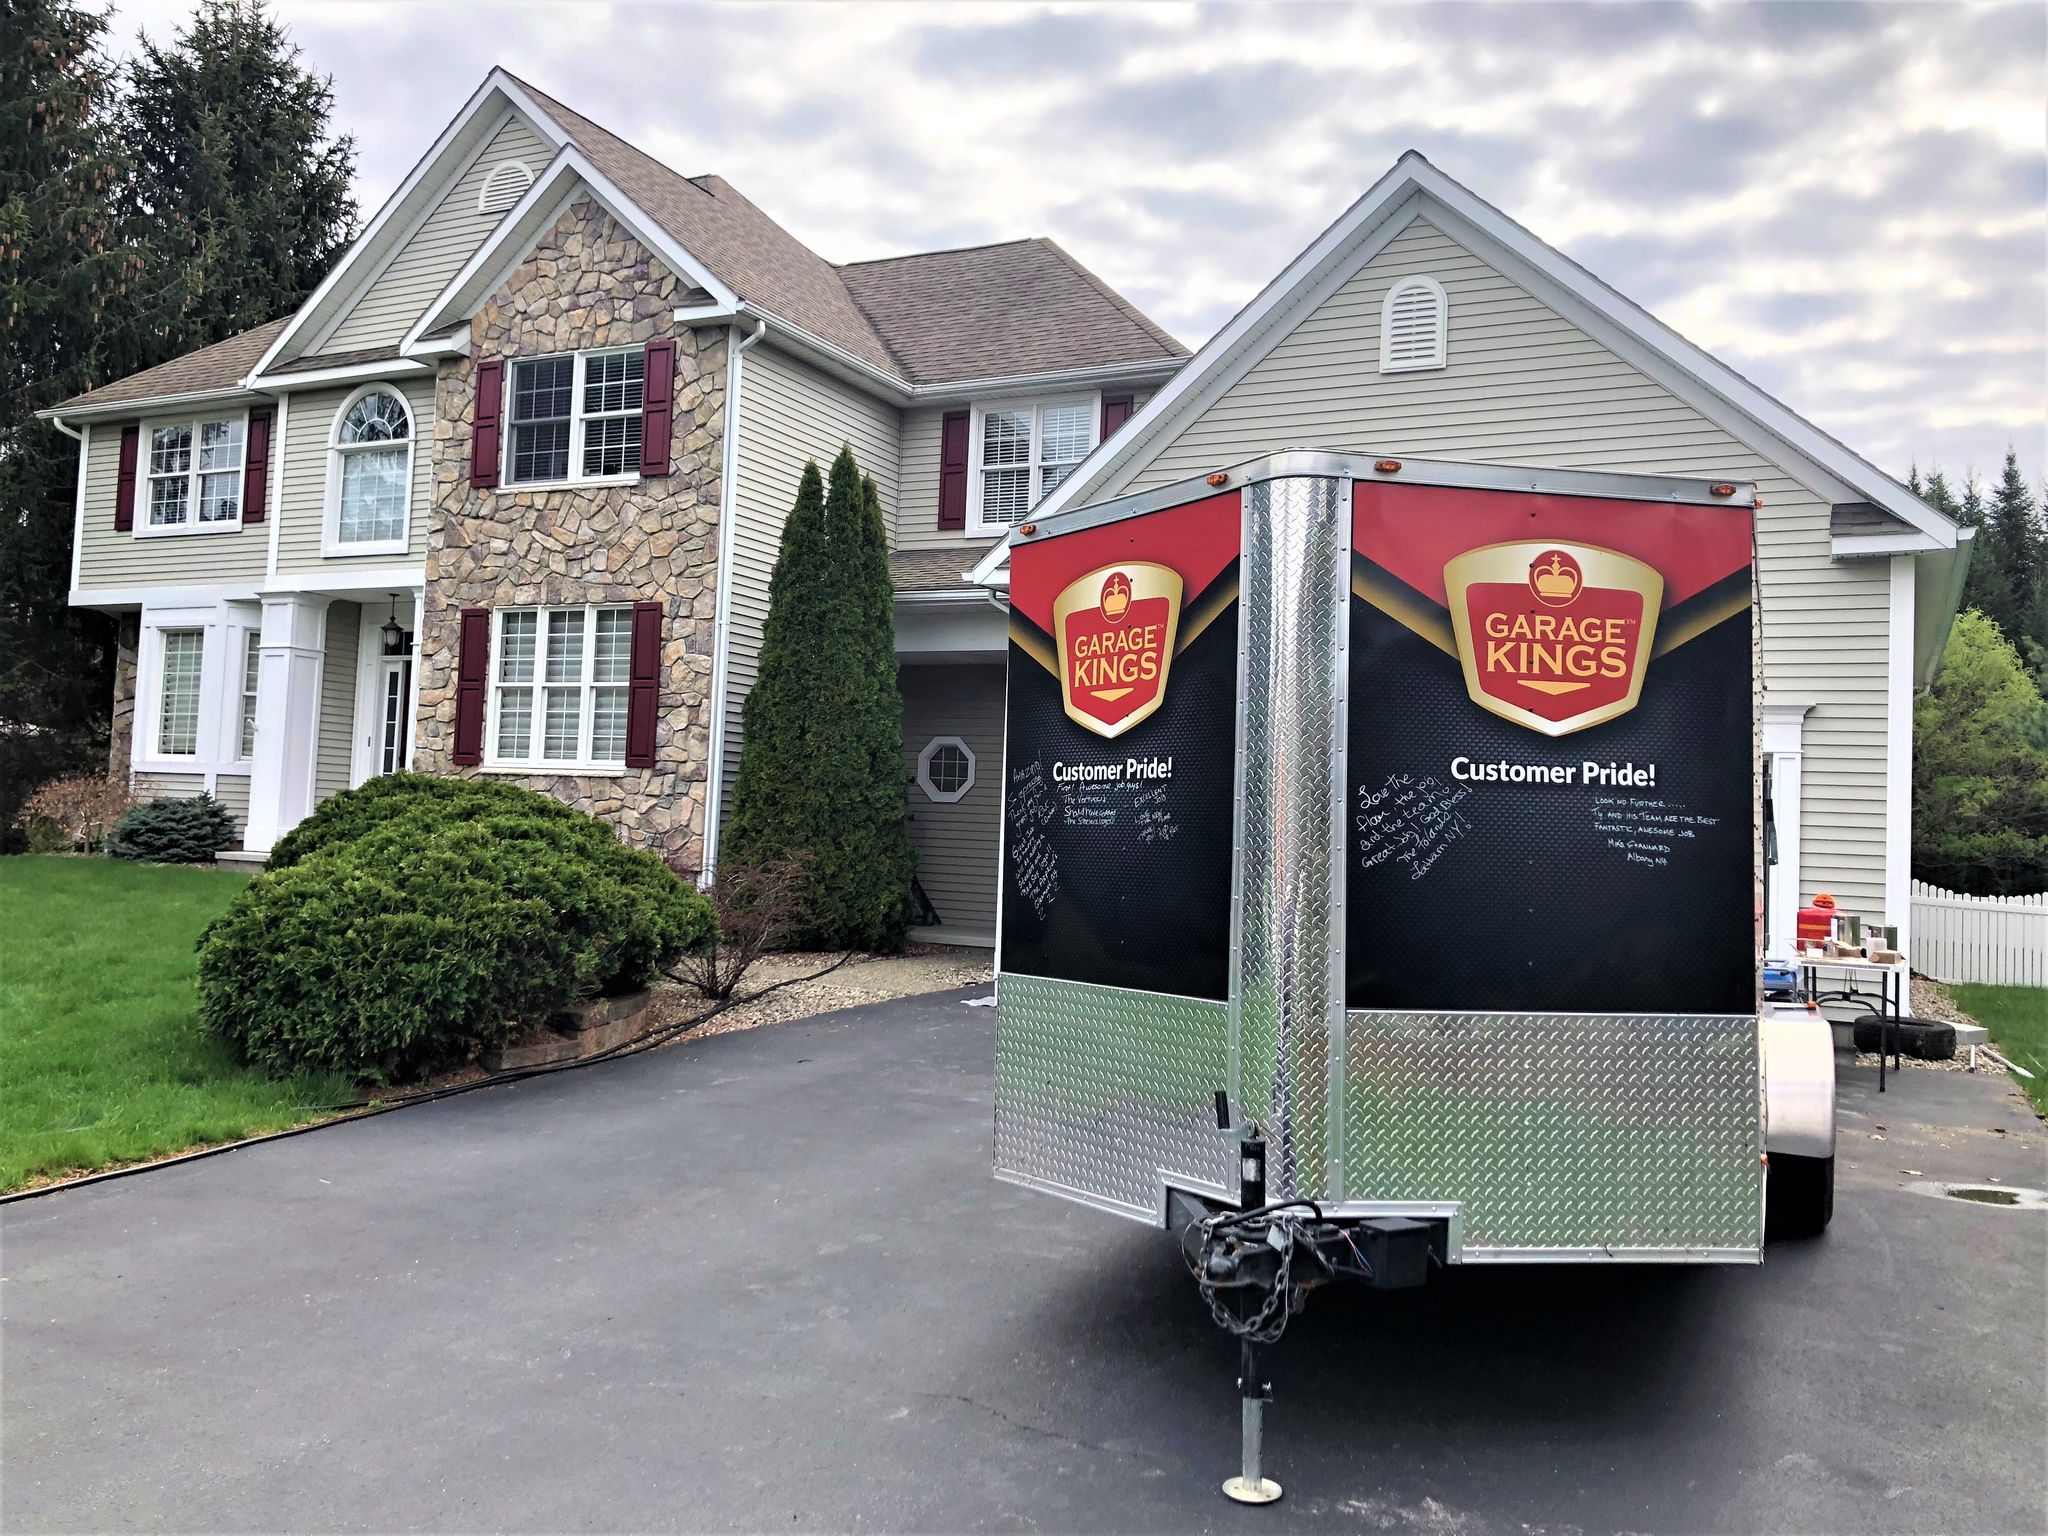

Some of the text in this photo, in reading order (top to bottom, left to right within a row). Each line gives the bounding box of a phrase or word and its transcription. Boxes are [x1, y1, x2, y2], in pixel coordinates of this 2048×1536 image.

[1074, 624, 1158, 658] GARAGE
[1485, 613, 1626, 644] GARAGE
[1073, 651, 1158, 688] KINGS
[1486, 640, 1627, 678] KINGS
[1053, 756, 1173, 782] Customer Pride!
[1450, 756, 1656, 787] Customer Pride!
[1358, 784, 1390, 809] Love
[1394, 790, 1417, 806] the
[1595, 796, 1615, 806] LOOK
[1607, 811, 1623, 820] AND
[1639, 811, 1663, 822] TEAM
[1679, 815, 1696, 824] THE
[1697, 815, 1720, 826] BEST
[1678, 829, 1697, 838] JOB
[1360, 830, 1385, 850] and
[1382, 819, 1405, 832] the
[1361, 842, 1396, 868] Great
[1420, 806, 1443, 824] God
